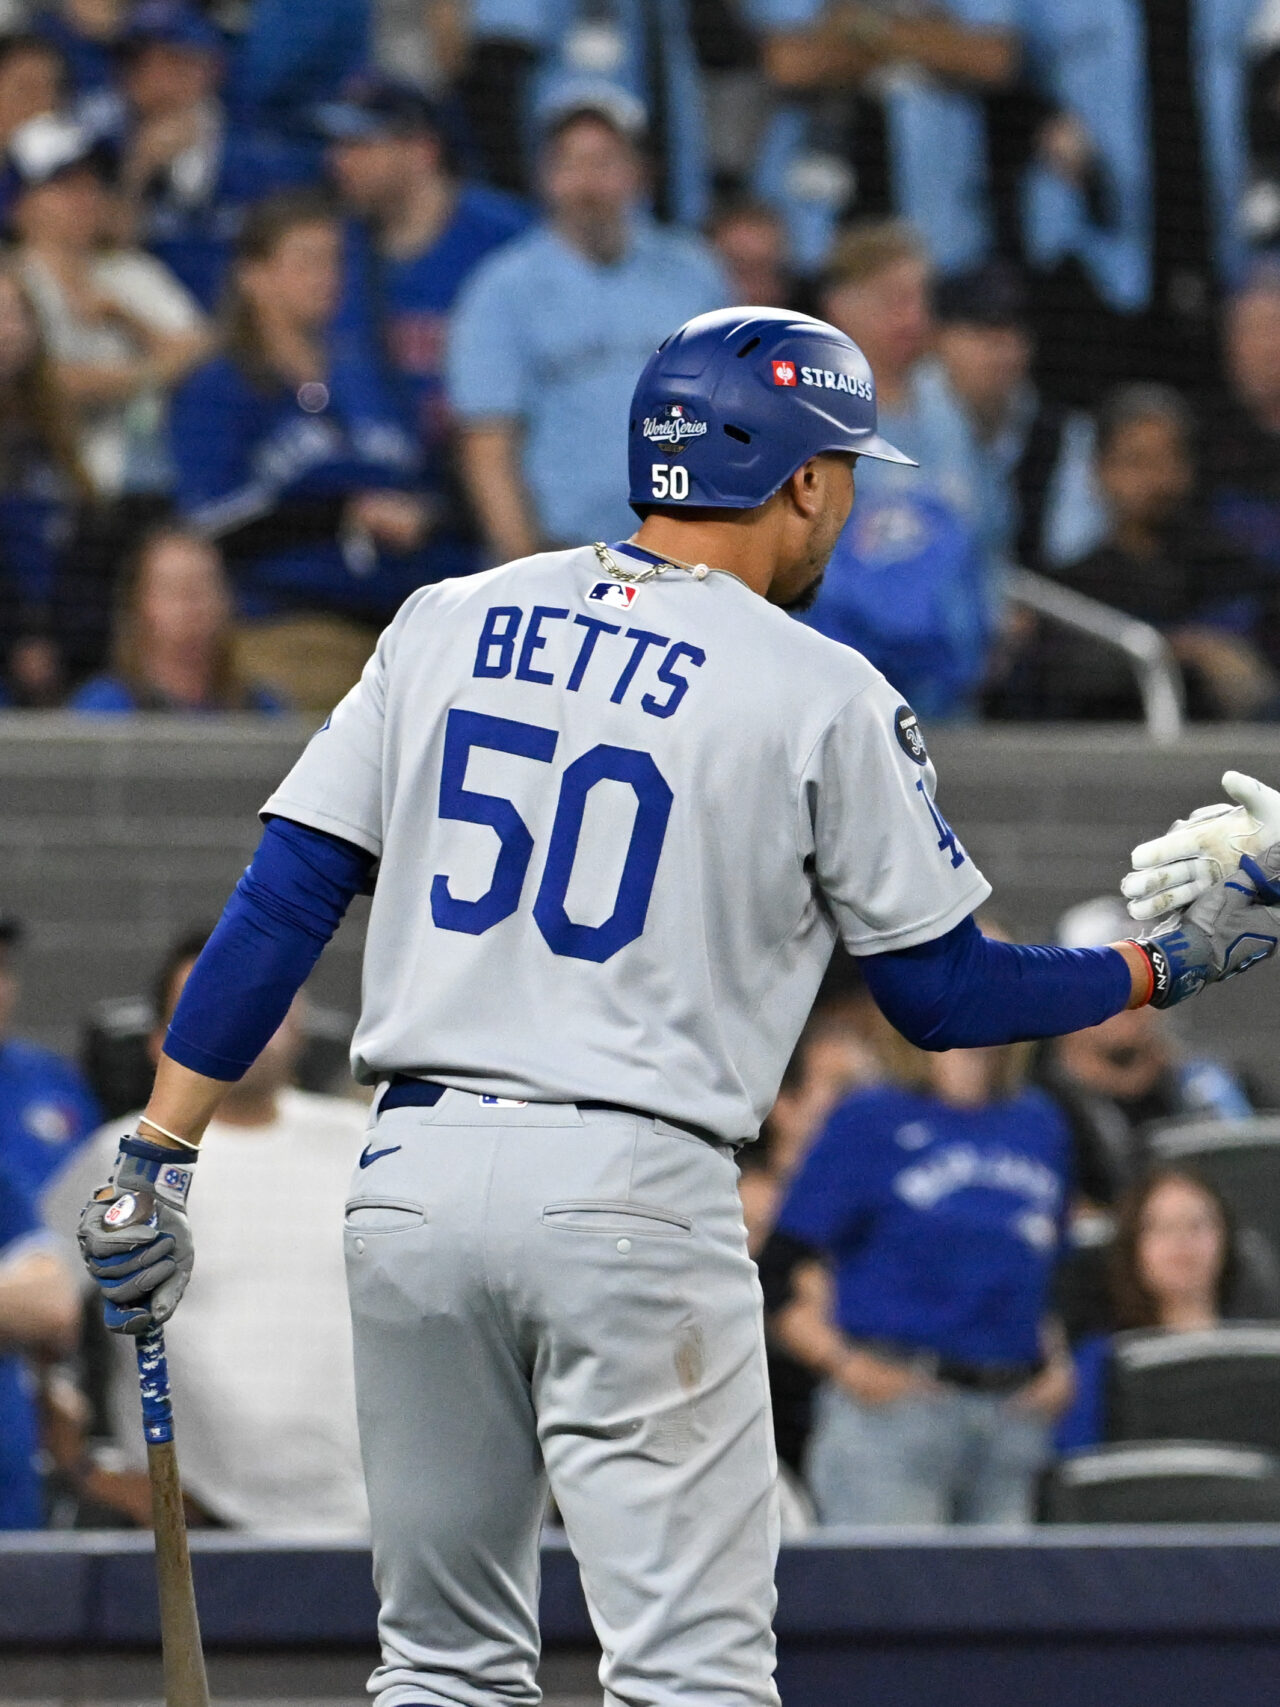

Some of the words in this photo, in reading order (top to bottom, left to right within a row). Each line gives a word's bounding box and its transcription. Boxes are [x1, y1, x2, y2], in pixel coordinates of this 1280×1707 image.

[800, 366, 872, 401] STRAUSS
[643, 417, 677, 441] World
[669, 417, 707, 443] Series
[652, 464, 689, 500] 50
[472, 605, 706, 719] BETTS
[430, 708, 674, 963] 50
